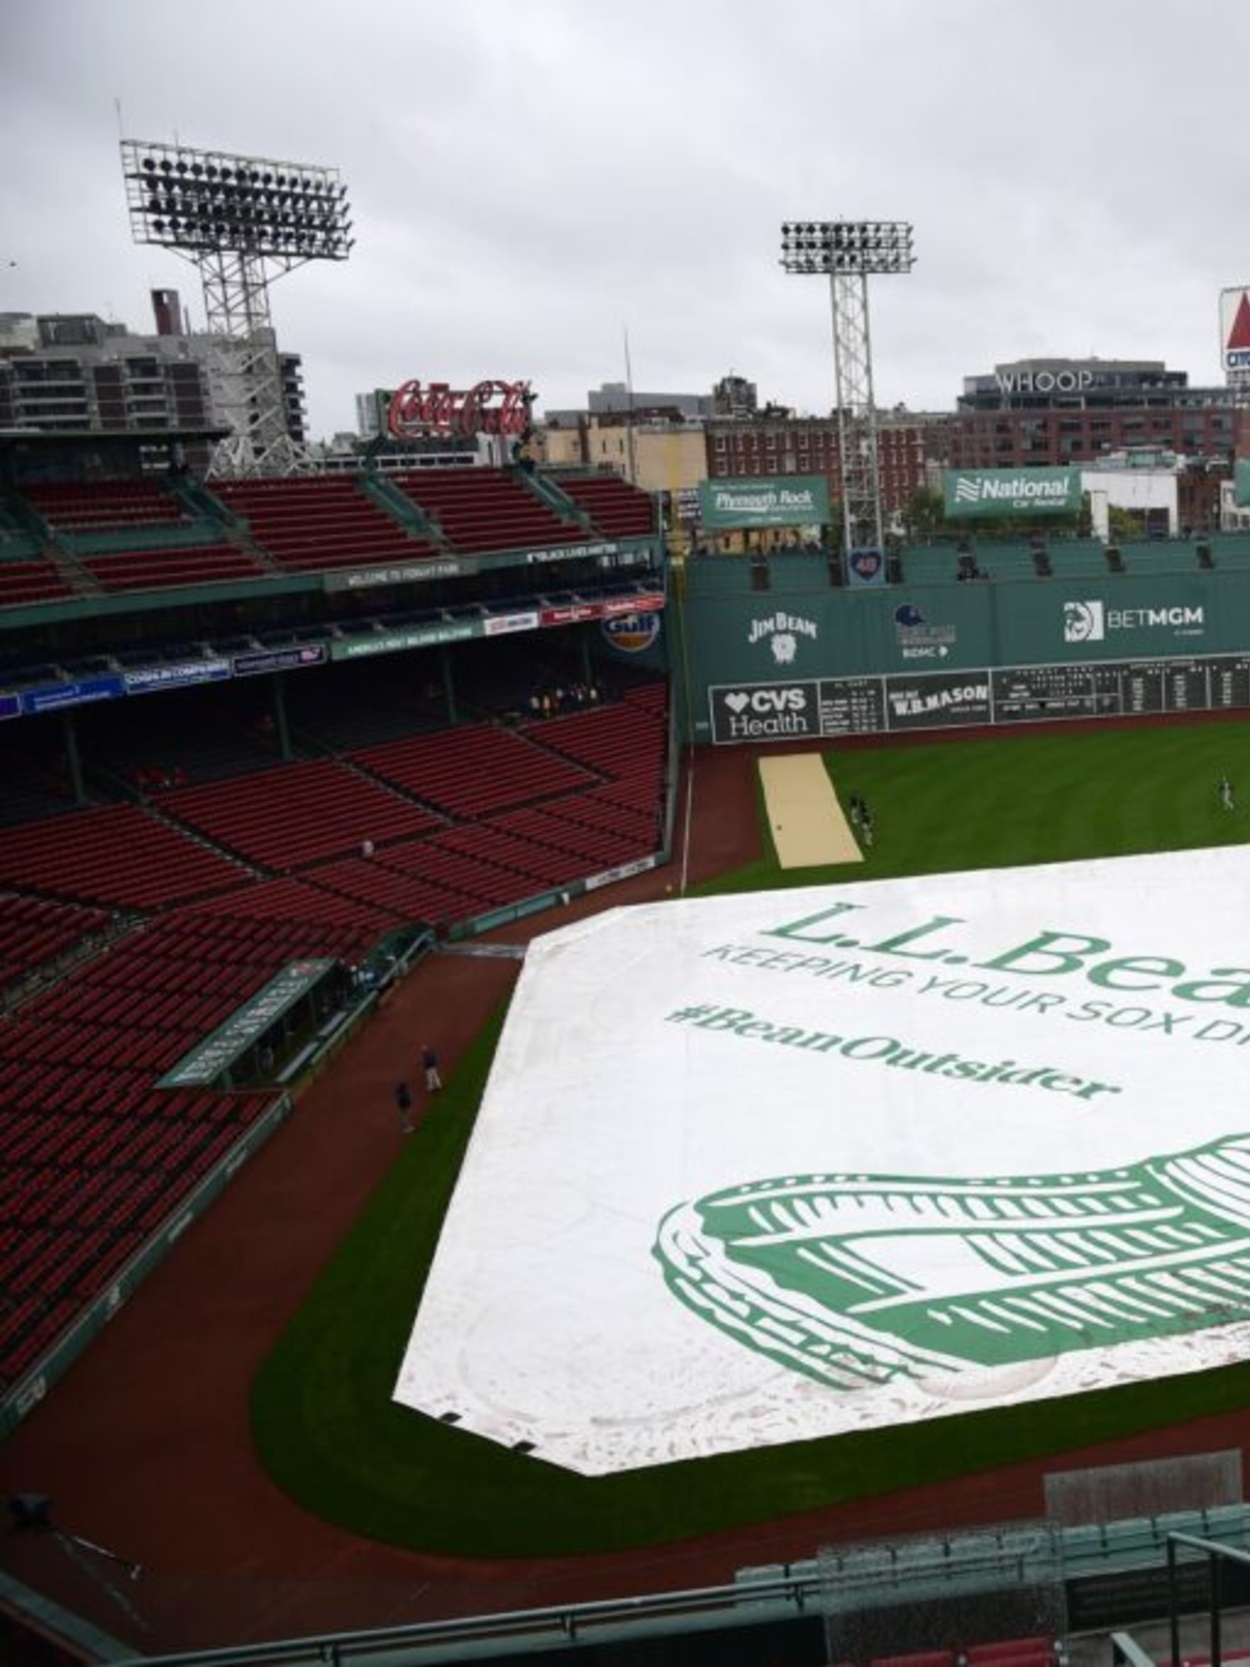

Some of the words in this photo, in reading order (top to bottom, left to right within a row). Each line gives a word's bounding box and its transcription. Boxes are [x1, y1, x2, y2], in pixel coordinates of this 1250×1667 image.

[996, 371, 1092, 392] WHOOP
[780, 490, 812, 504] Rock
[982, 477, 1069, 499] National
[605, 614, 655, 632] Gulf
[748, 619, 774, 643] JIM
[776, 611, 817, 639] BEAM
[1107, 606, 1204, 629] BETMGM
[751, 689, 806, 711] CVS
[729, 713, 808, 736] Health
[701, 944, 913, 988] KEEPING
[917, 973, 1066, 1015] YOUR
[1066, 1000, 1193, 1035] SOX
[663, 1002, 1122, 1101] #BeanOutsider
